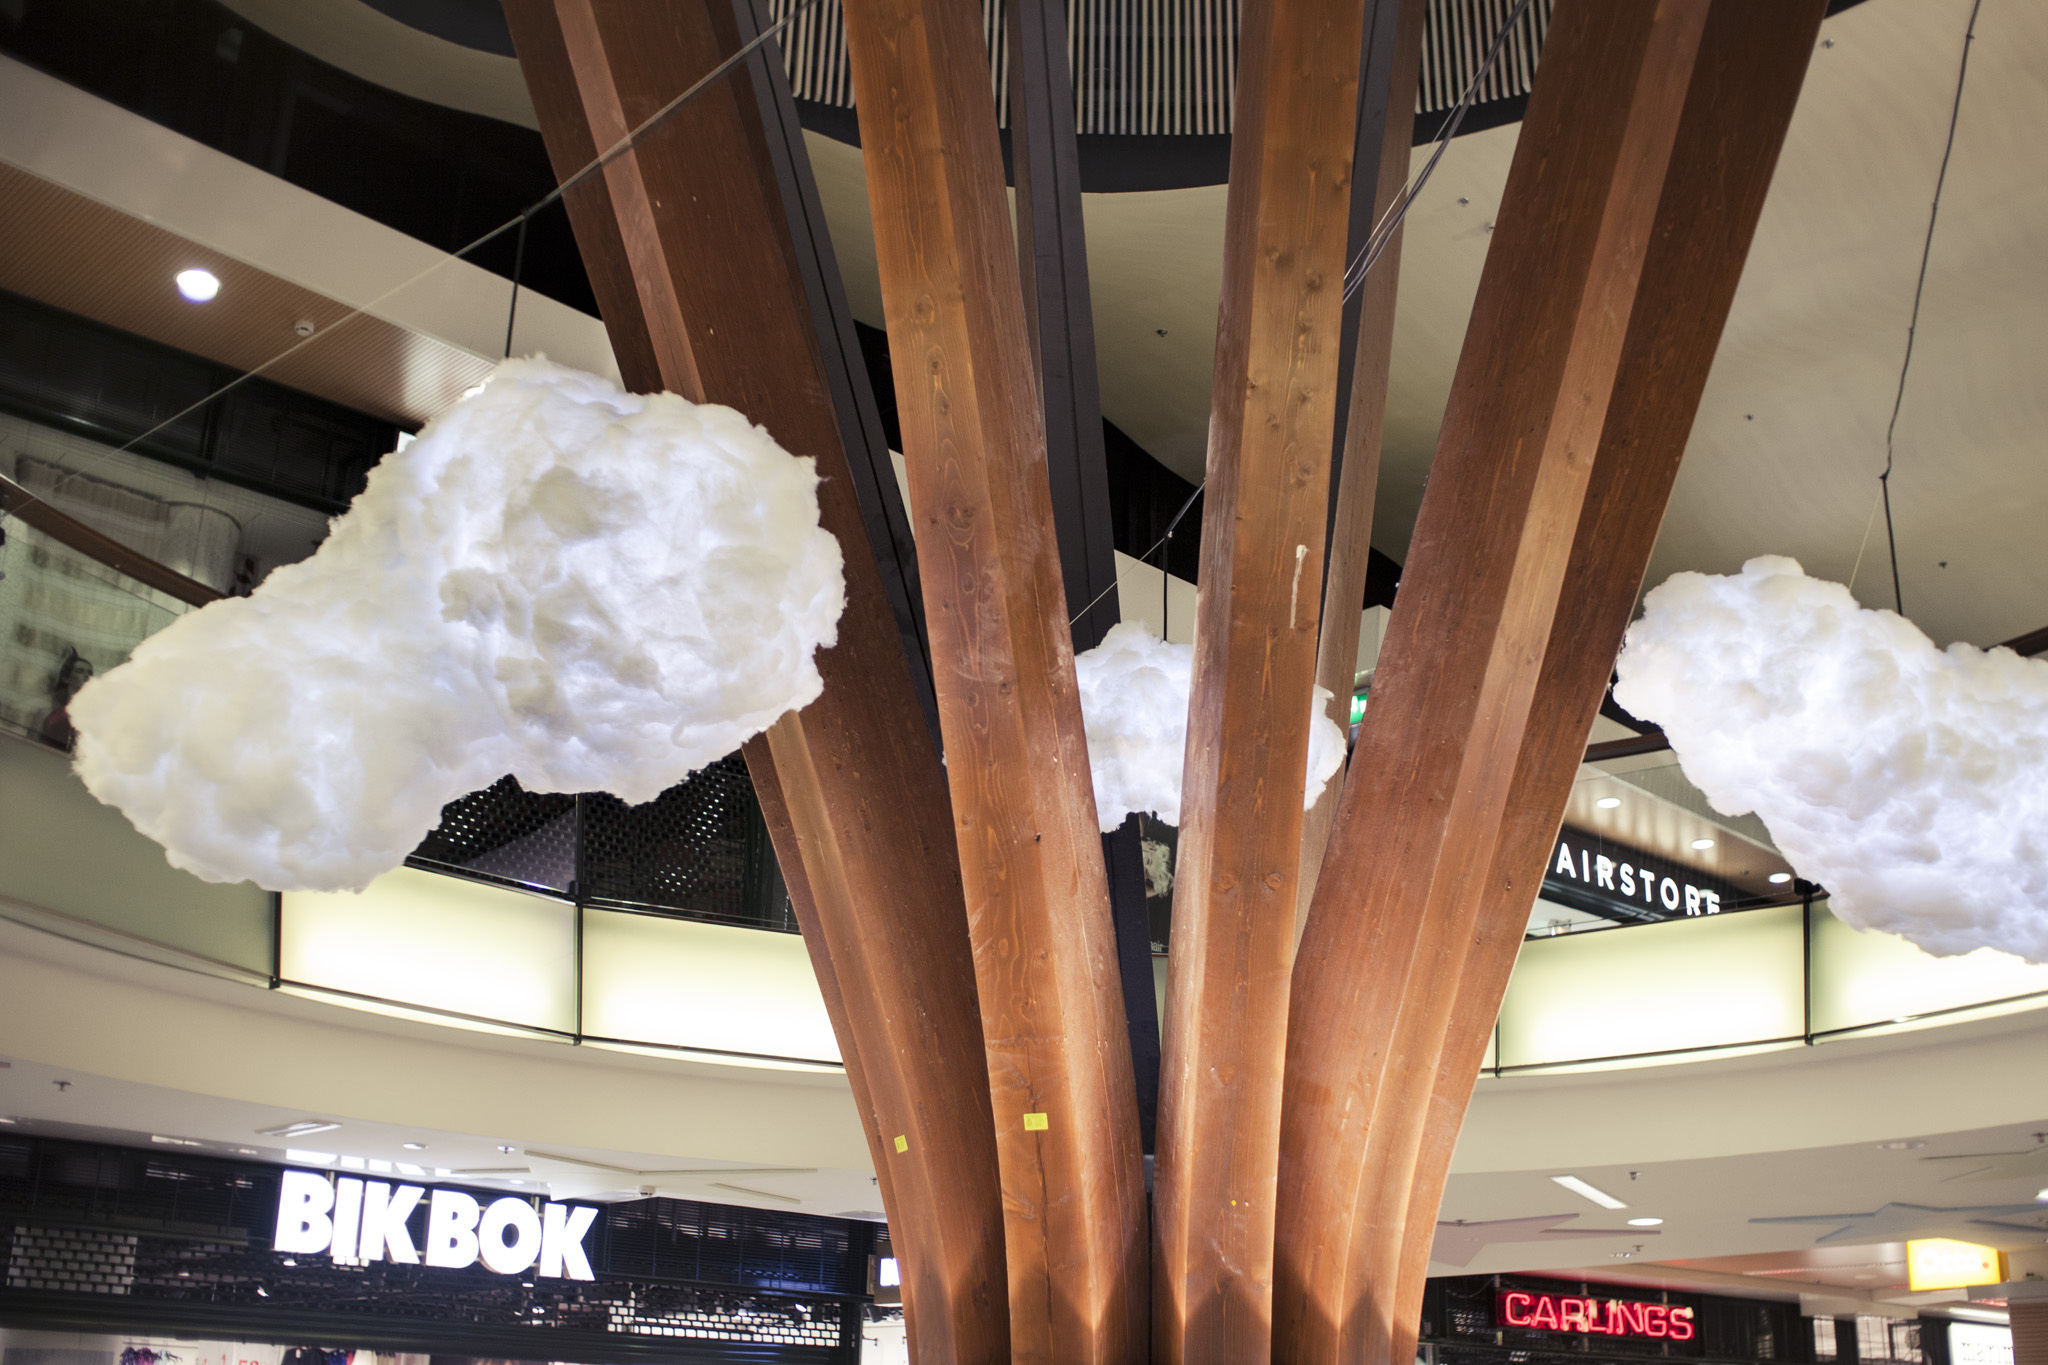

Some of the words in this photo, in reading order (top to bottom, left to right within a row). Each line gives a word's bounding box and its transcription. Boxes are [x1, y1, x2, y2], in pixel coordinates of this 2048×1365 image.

[274, 1170, 425, 1265] BIK
[425, 1189, 599, 1281] BOK
[1505, 1292, 1695, 1340] CARLINGS
